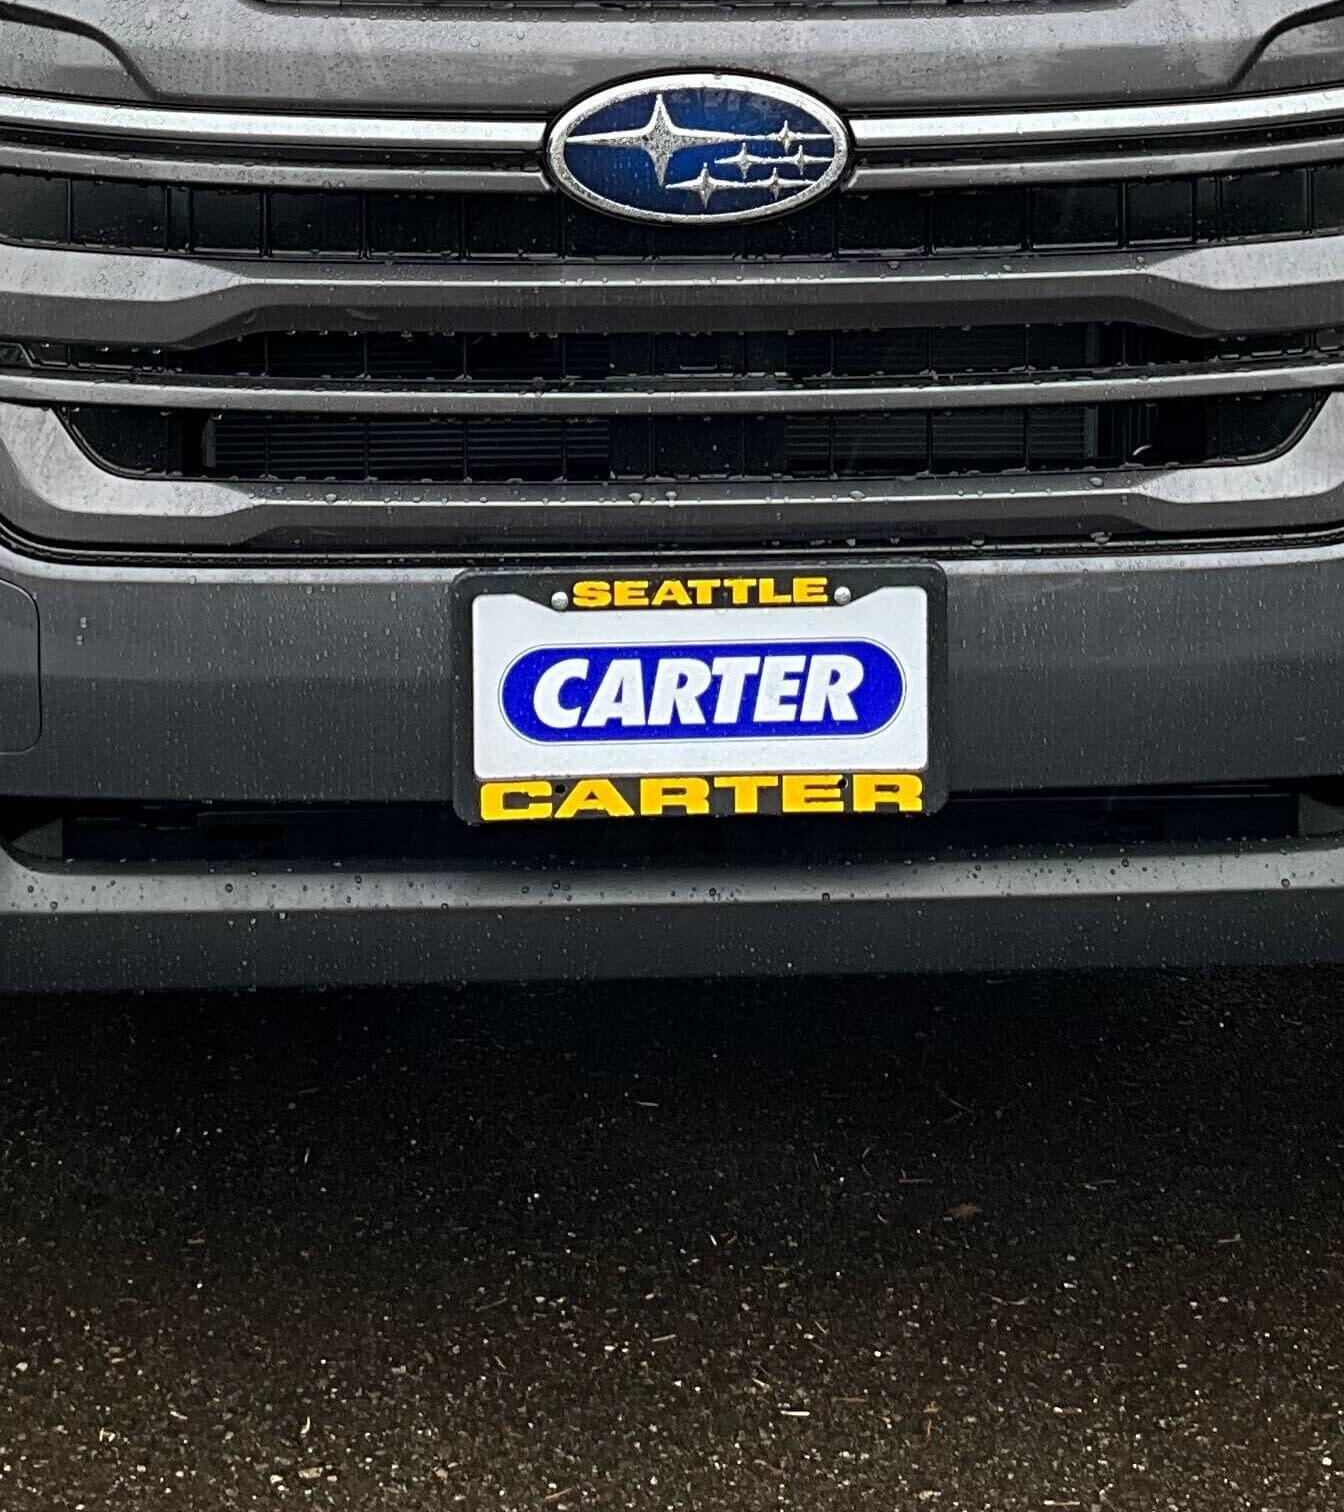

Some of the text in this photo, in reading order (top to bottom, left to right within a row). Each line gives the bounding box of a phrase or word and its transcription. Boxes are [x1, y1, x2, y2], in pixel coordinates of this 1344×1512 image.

[572, 576, 829, 607] SEATTLE
[532, 653, 865, 729] CARTER
[480, 774, 923, 821] CARTER
